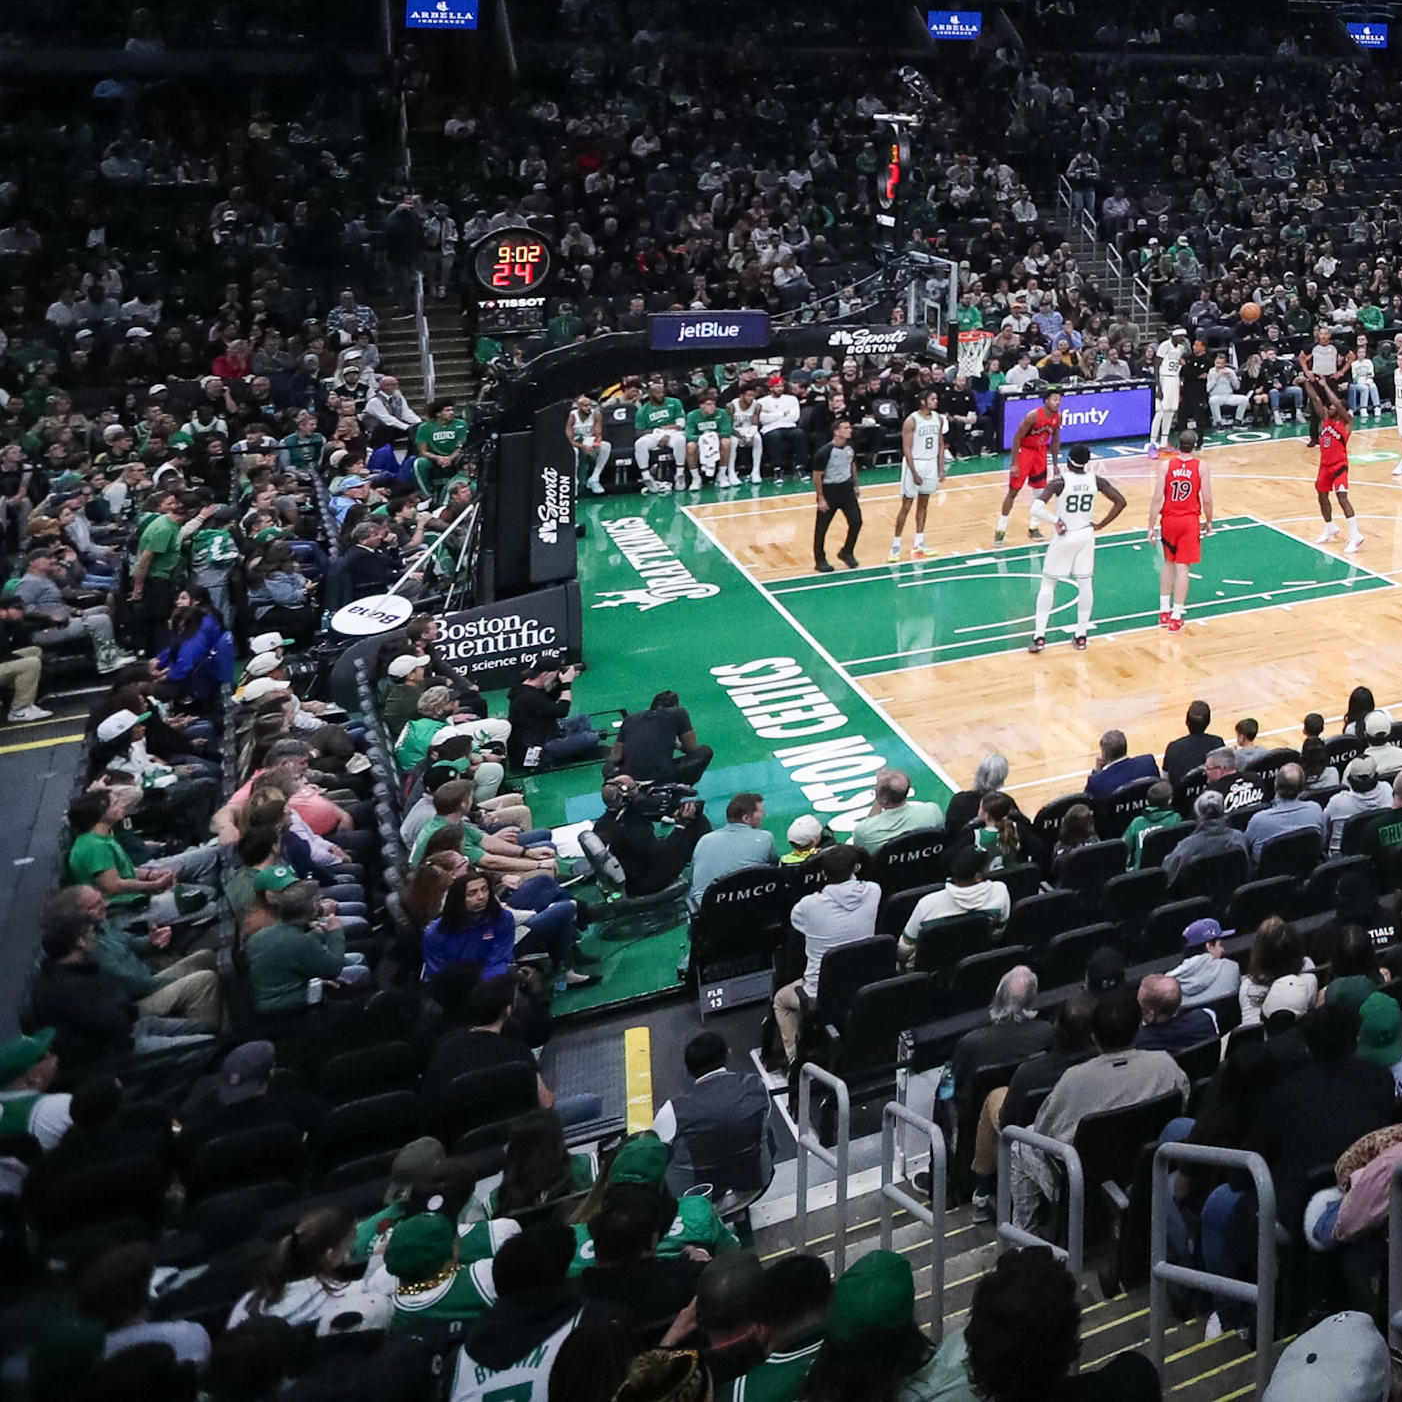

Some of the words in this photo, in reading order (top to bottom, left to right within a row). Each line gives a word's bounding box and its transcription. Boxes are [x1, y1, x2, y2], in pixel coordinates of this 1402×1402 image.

[410, 11, 474, 20] ARBELLA
[931, 24, 978, 32] ARBELLA
[498, 246, 541, 263] 9:02
[492, 264, 534, 286] 24
[496, 298, 545, 308] TISSOT
[678, 321, 740, 342] jetBlue
[851, 328, 907, 345] Sports
[846, 343, 897, 354] BOSTON
[924, 437, 934, 449] 8
[540, 466, 558, 520] Sports
[558, 475, 570, 524] BOSTON
[1171, 481, 1192, 502] 19
[1066, 494, 1093, 514] 88
[471, 655, 517, 672] science
[709, 656, 849, 739] CELTICS
[1223, 787, 1264, 814] Celtics
[887, 842, 945, 865] PIMCO
[716, 881, 777, 906] PIMCO
[706, 988, 724, 998] FLR
[708, 997, 722, 1008] 13
